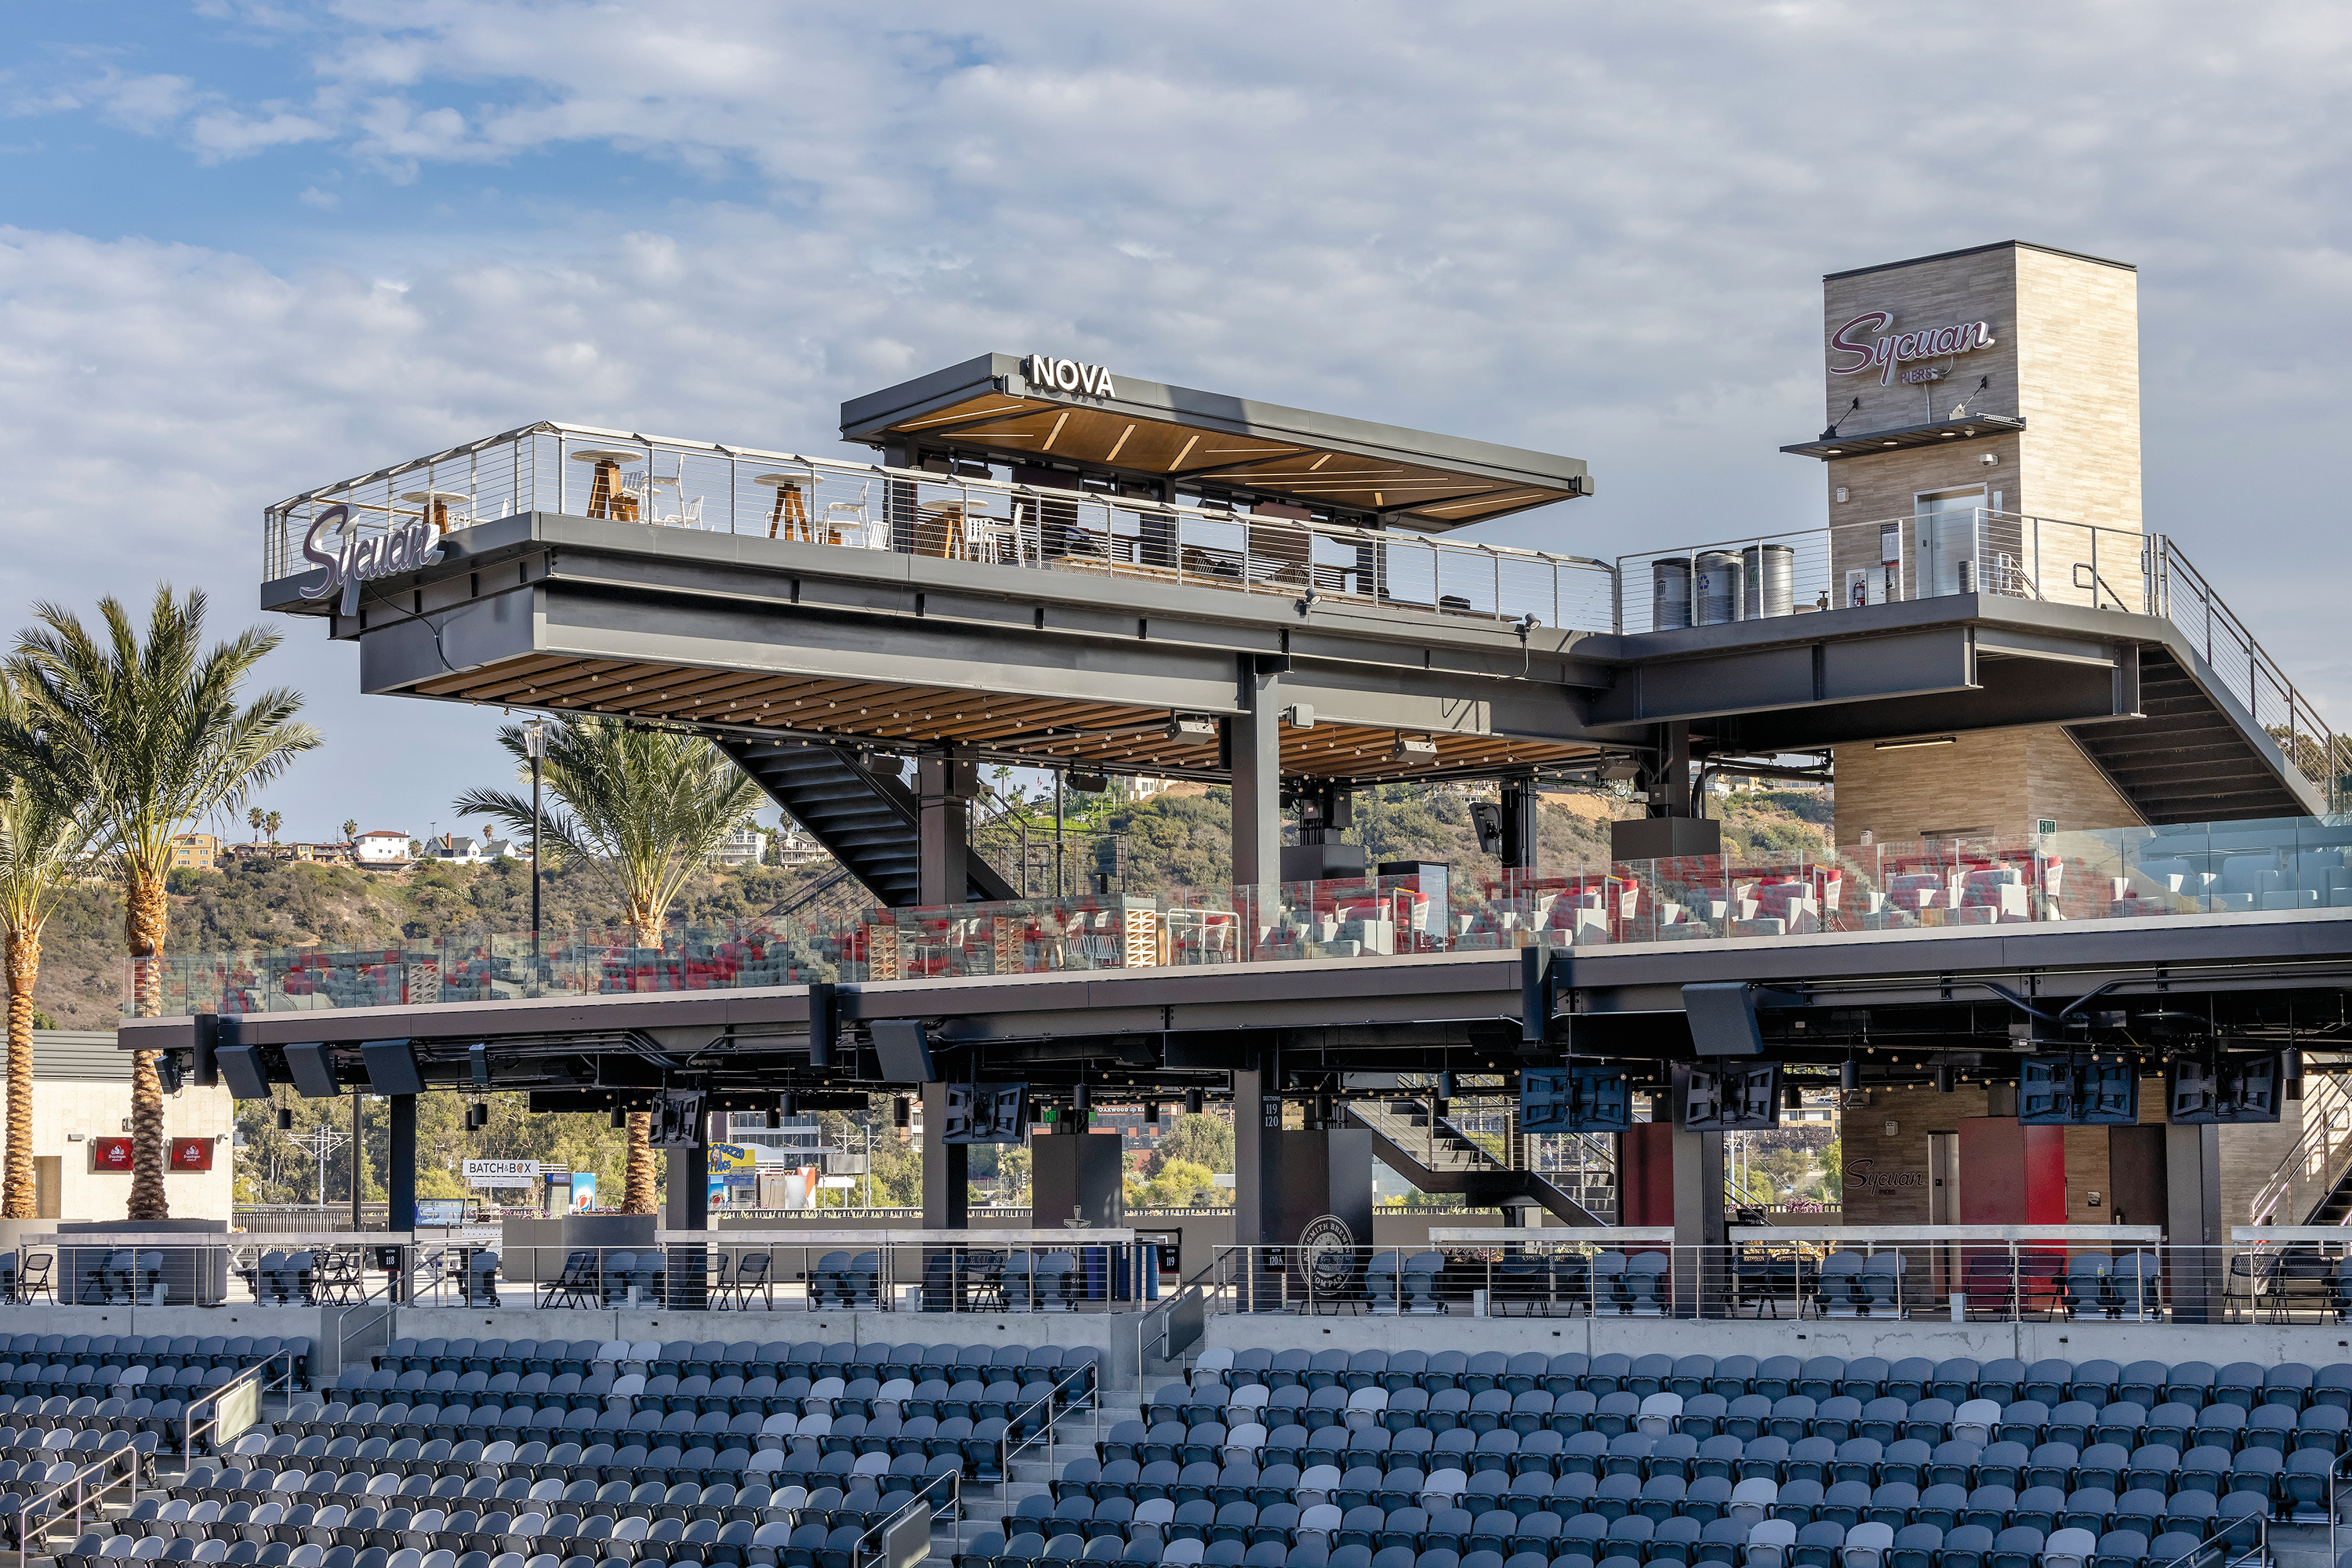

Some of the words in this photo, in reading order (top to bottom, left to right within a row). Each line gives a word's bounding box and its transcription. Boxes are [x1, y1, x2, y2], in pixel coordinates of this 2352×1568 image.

[1829, 310, 1996, 387] Sycuan
[1030, 353, 1117, 398] NOVA
[1900, 367, 1939, 385] PIERS
[299, 503, 445, 617] Sycuan
[2041, 821, 2054, 833] EXIT
[1265, 1103, 1278, 1115] 119
[1045, 1110, 1057, 1122] EXIT
[1265, 1116, 1279, 1127] 120
[1844, 1157, 1926, 1197] Sycuan
[1330, 1222, 1351, 1254] BREWIN
[386, 1255, 395, 1265] 118
[1167, 1256, 1175, 1266] 119
[1269, 1255, 1279, 1266] 120
